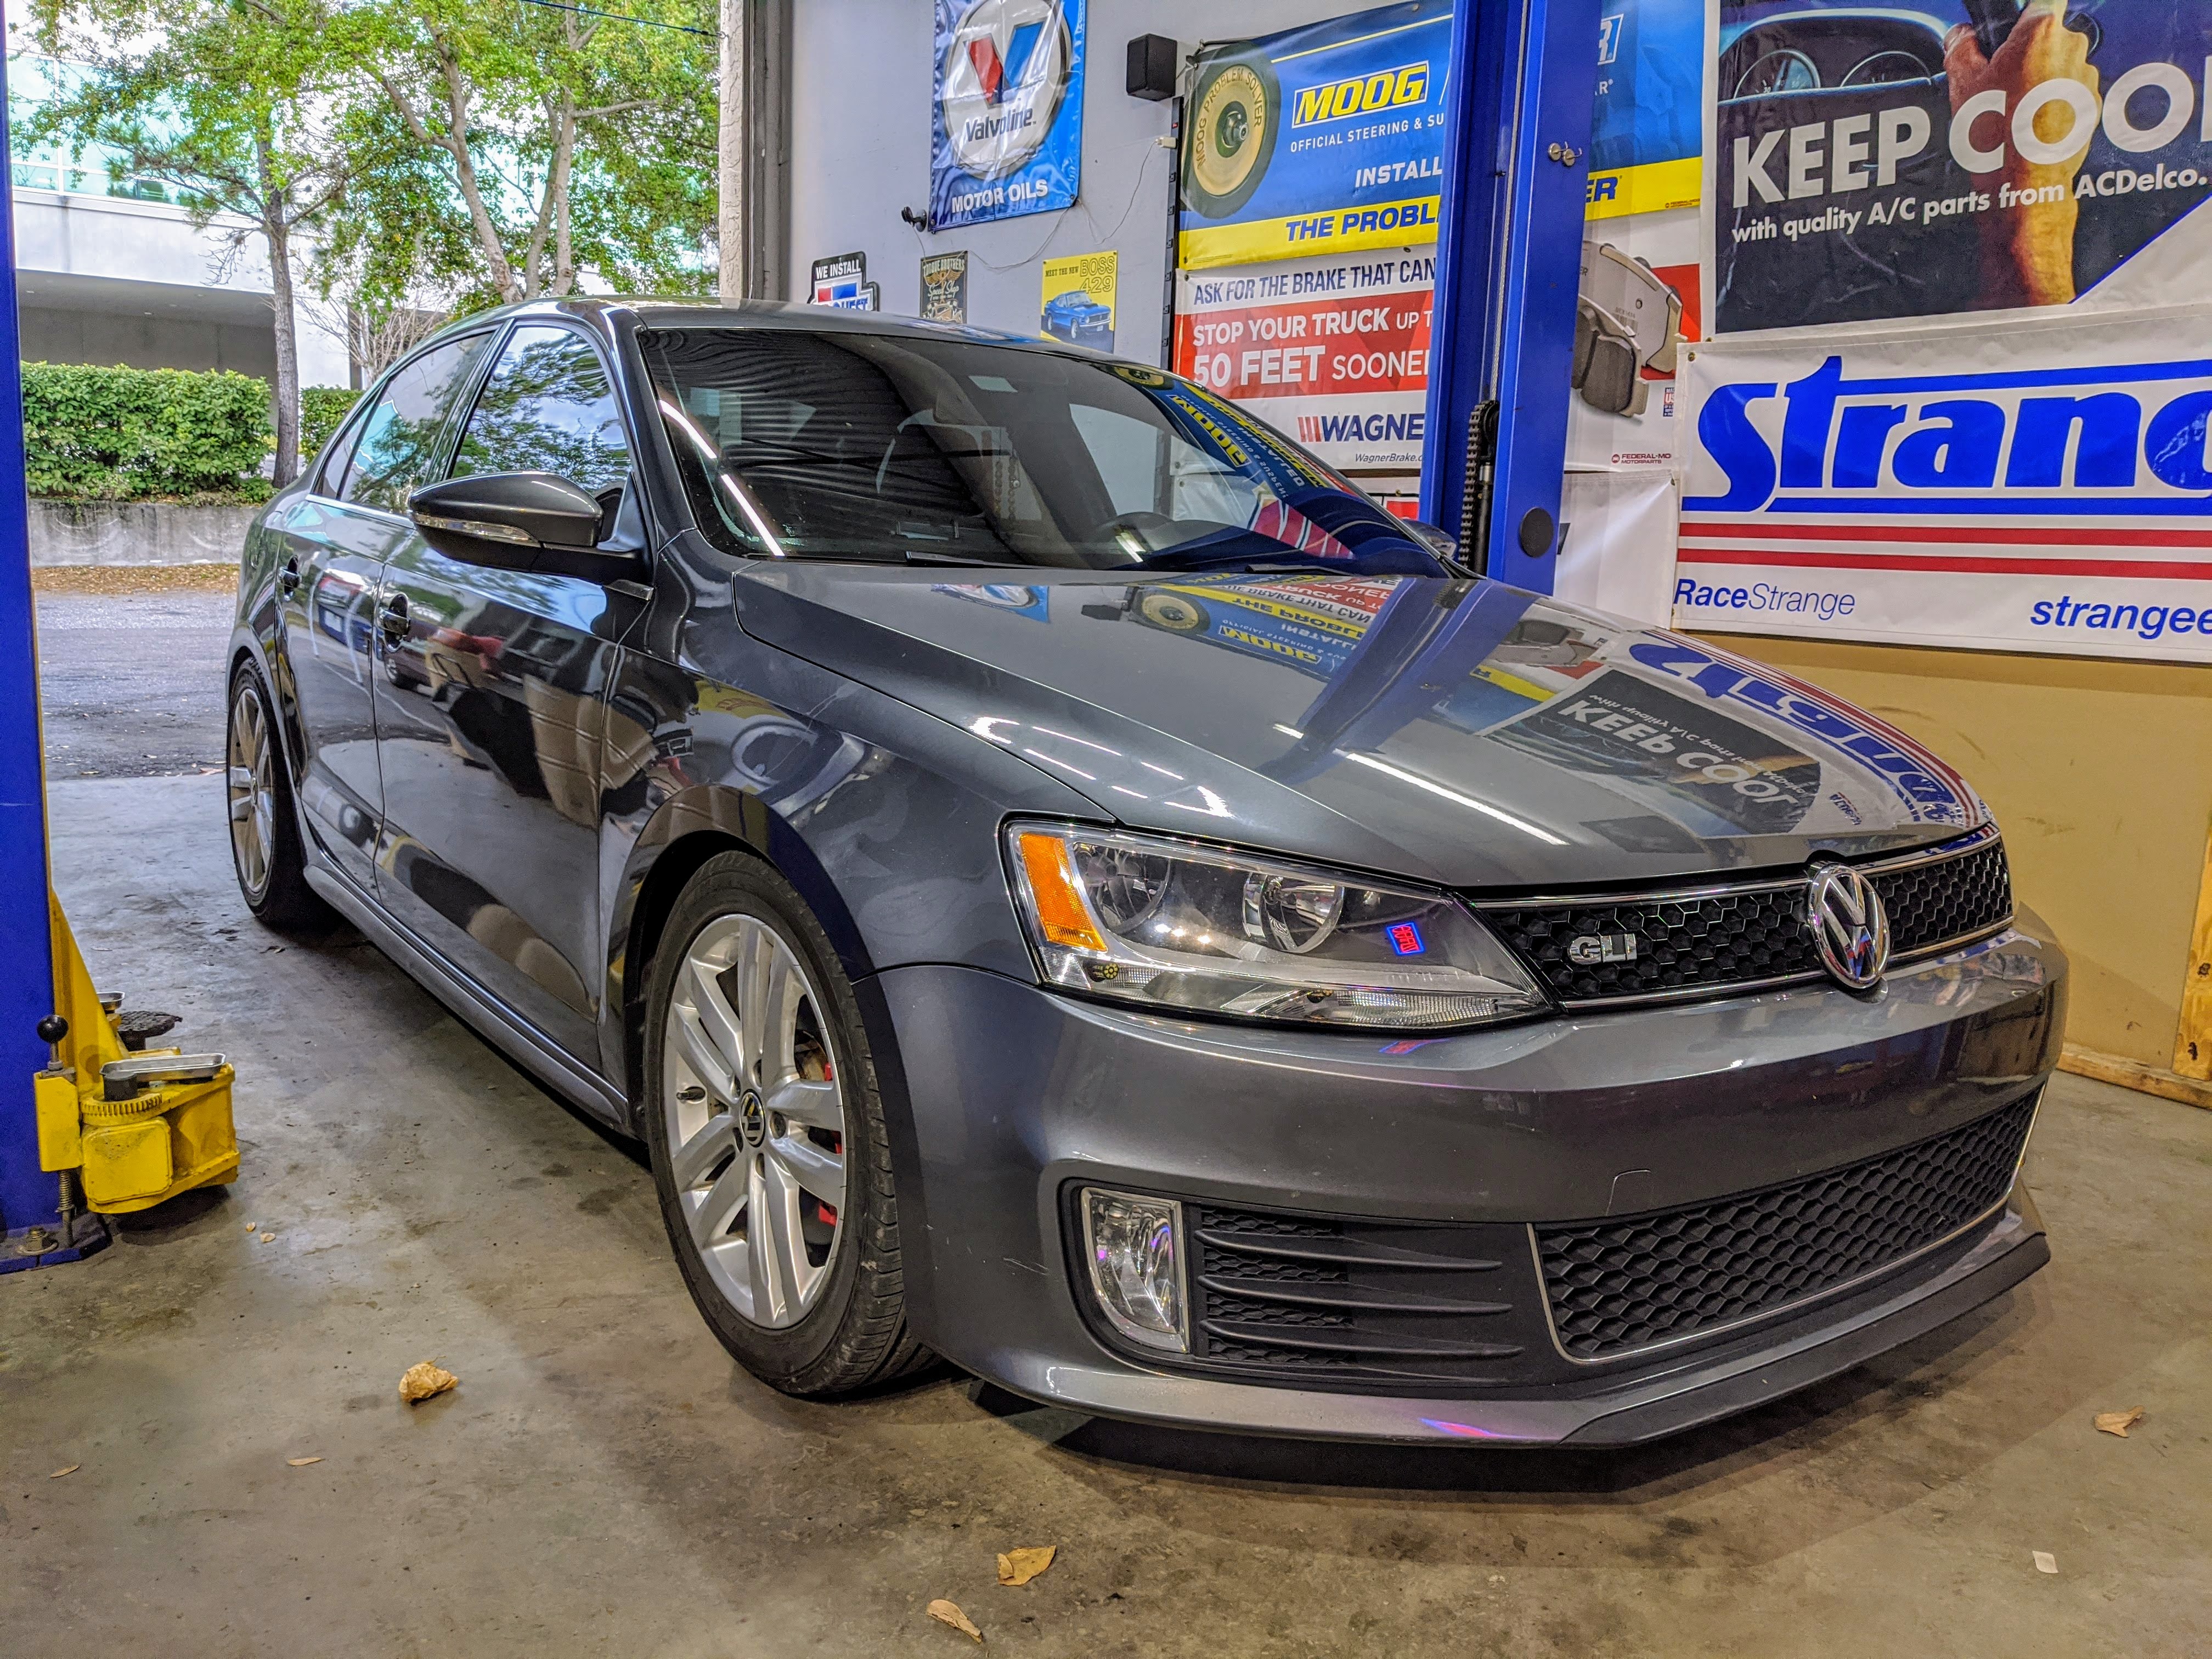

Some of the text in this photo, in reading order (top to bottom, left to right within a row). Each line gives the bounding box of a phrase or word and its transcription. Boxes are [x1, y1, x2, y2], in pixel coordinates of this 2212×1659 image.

[1296, 65, 1427, 125] MOOG
[966, 106, 1034, 142] Valvoline
[1197, 68, 1262, 169] MOOG PROBLEM SOLVER
[1290, 133, 1343, 153] OFFICIAL
[1347, 120, 1409, 142] STEERING
[1414, 117, 1423, 129] &
[1355, 156, 1442, 188] INSTALL
[1733, 106, 1931, 208] KEEP
[951, 179, 1048, 213] MOTOR OILS
[1732, 163, 2208, 243] with quality A/C parts from ACDelco.
[1286, 204, 1439, 241] THE PROBL
[816, 259, 861, 280] WE INSTALL
[1045, 269, 1058, 277] MEET
[1069, 266, 1079, 274] NEW
[1080, 256, 1115, 277] BOSS
[1079, 275, 1114, 294] 429
[1194, 258, 1436, 305] ASK FOR THE BRAKE THAT CAN
[1193, 322, 1243, 347] STOP
[1248, 315, 1306, 341] YOUR
[1312, 307, 1391, 336] TRUCK
[1396, 312, 1419, 329] UP
[1193, 353, 1232, 388] 50
[1242, 346, 1325, 385] FEET
[1321, 413, 1425, 442] WAGNE
[1673, 578, 1855, 621] RaceStrange
